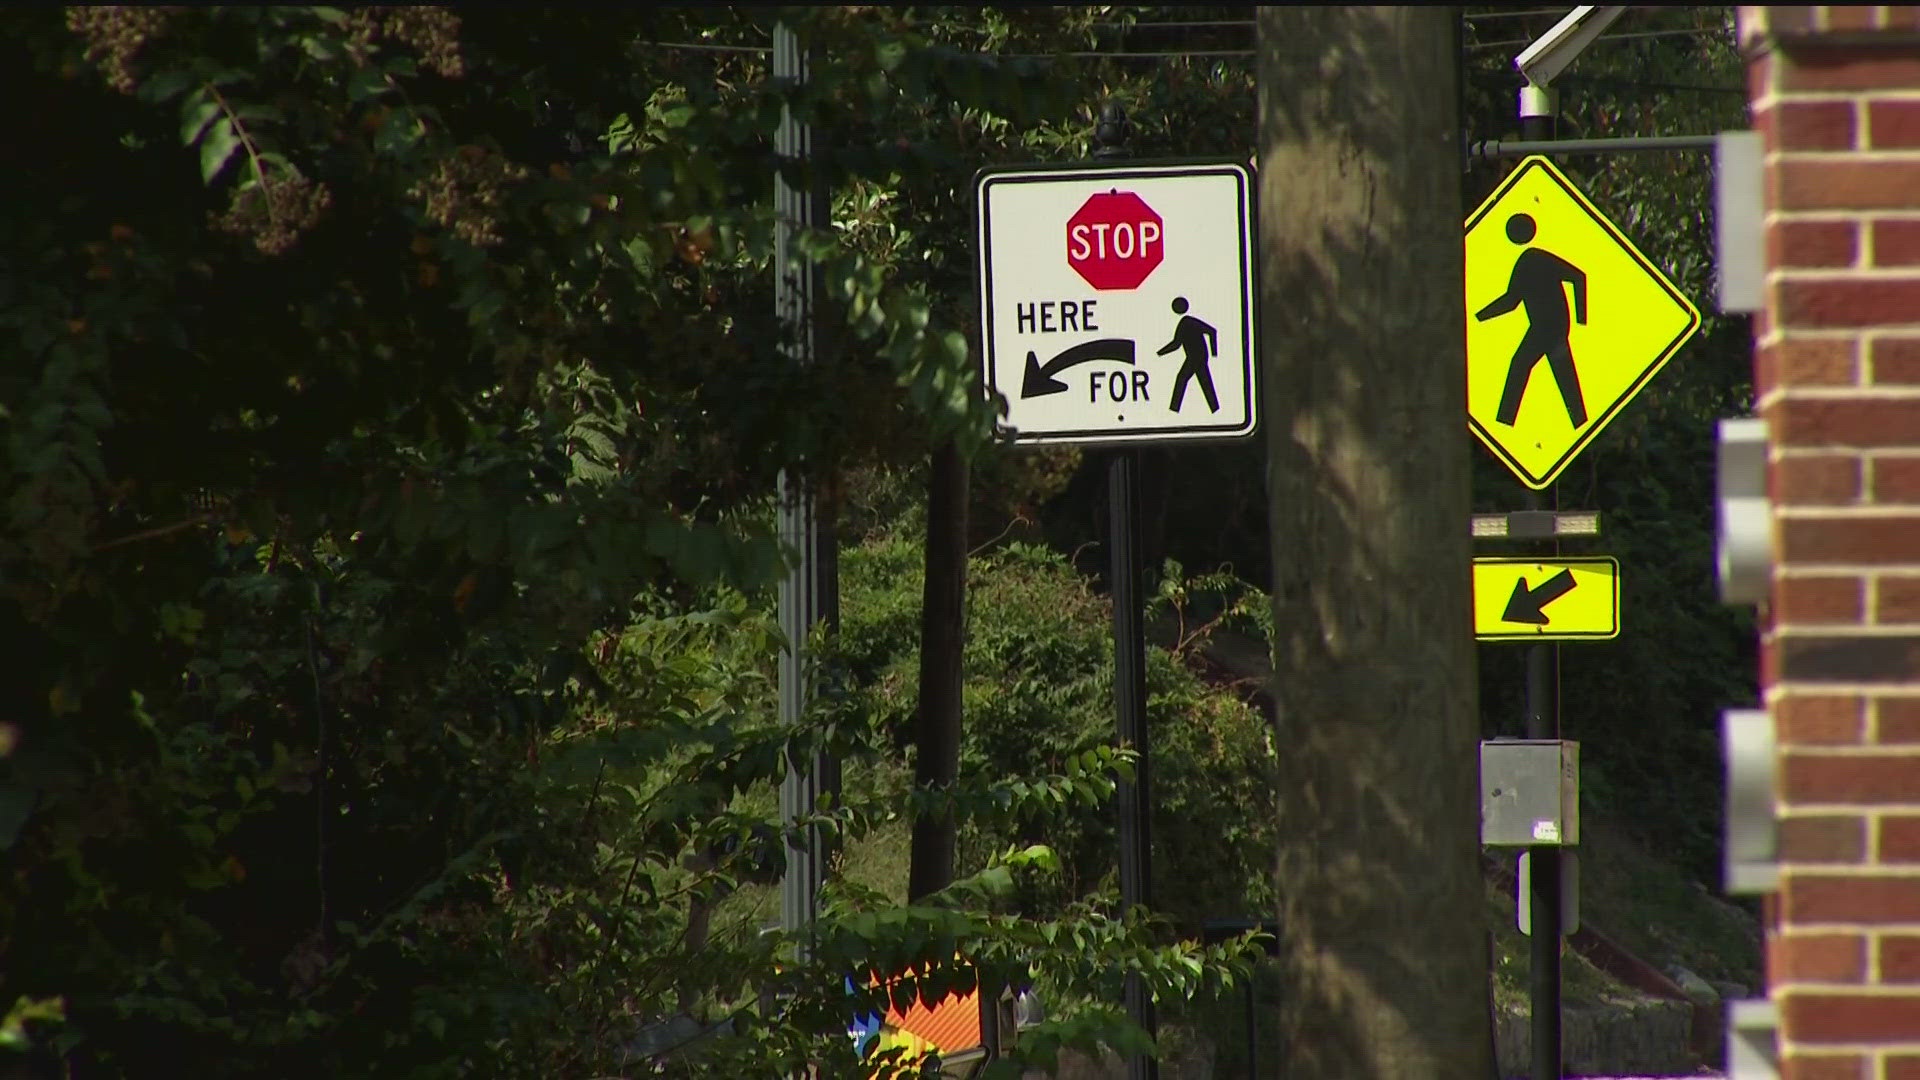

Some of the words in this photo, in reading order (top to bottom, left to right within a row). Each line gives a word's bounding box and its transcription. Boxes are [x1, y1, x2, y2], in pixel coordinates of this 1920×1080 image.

[1071, 221, 1160, 260] STOP
[1017, 300, 1099, 334] HERE
[1090, 370, 1150, 403] FOR
